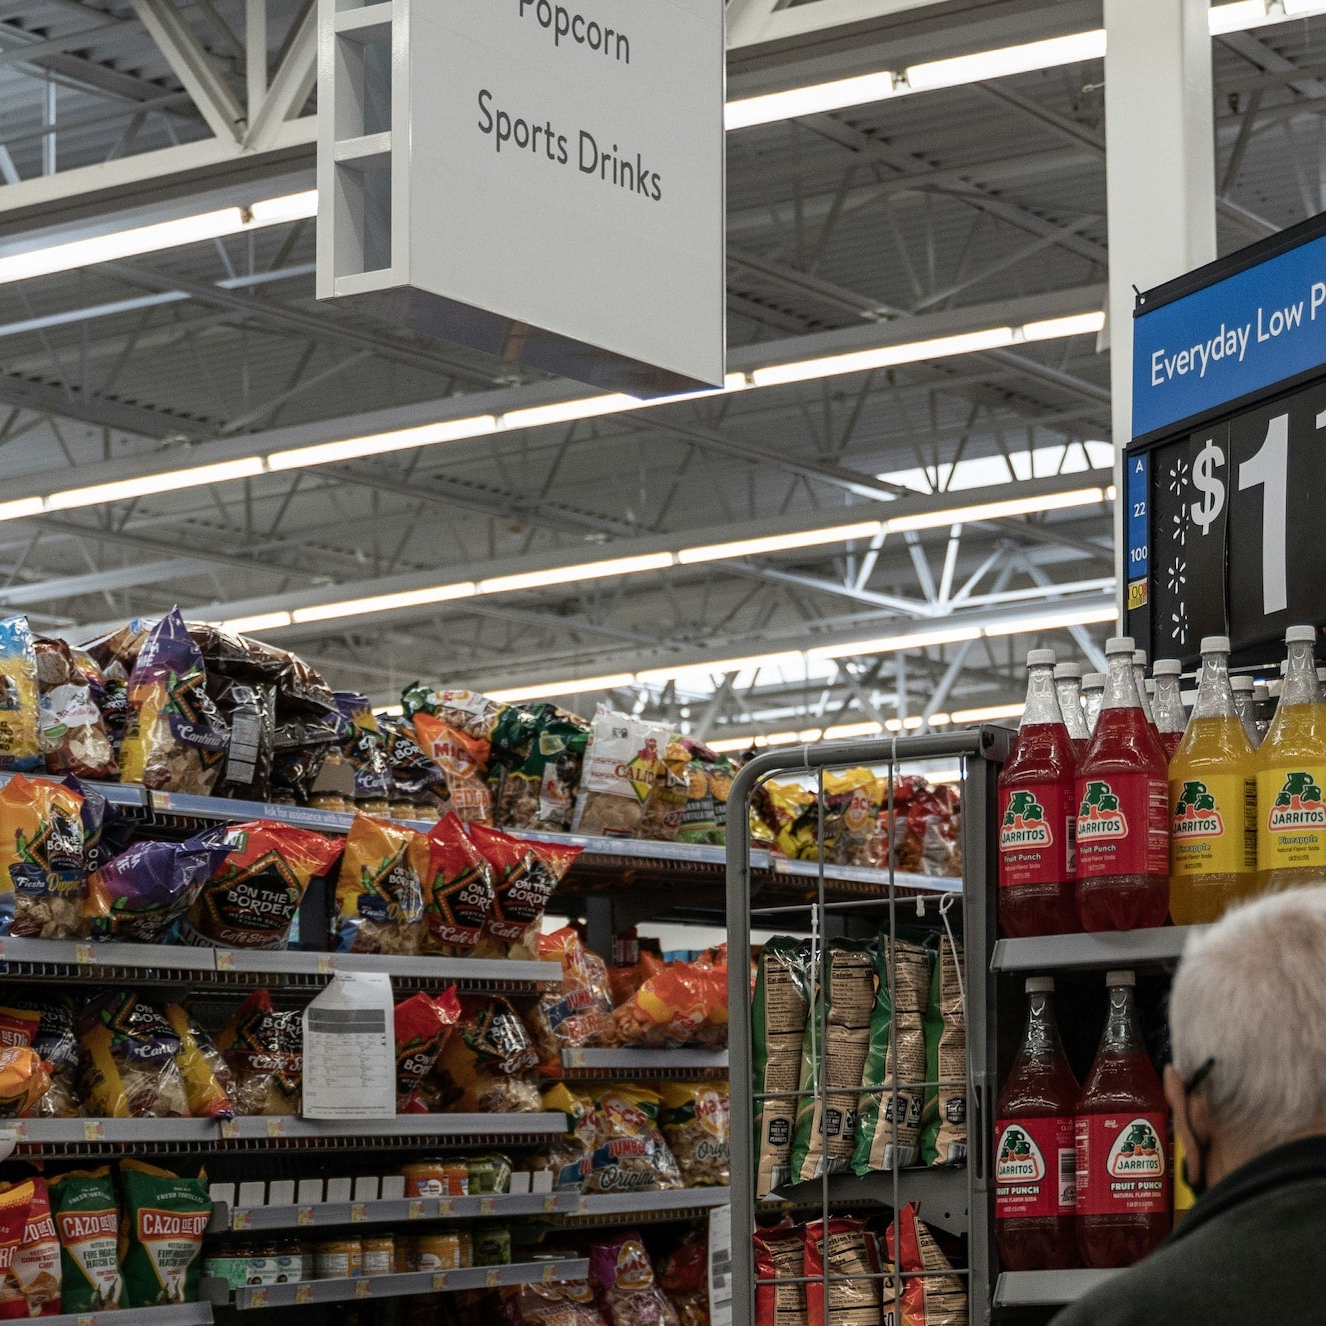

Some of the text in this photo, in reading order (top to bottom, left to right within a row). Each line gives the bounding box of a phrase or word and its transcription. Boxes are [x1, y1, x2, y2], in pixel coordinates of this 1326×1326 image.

[478, 90, 662, 201] Sports Drinks
[1150, 323, 1251, 387] Everyday
[1257, 301, 1302, 343] Low
[1135, 459, 1144, 474] A
[1134, 502, 1145, 517] 22
[1130, 546, 1148, 562] 100
[177, 725, 222, 747] Cantina
[1273, 811, 1324, 825] JARRITOS
[1078, 821, 1120, 834] JARRITOS
[1174, 820, 1217, 833] JARRITOS
[1002, 830, 1045, 843] JARRITOS
[1278, 836, 1318, 845] Pineapple
[1019, 854, 1041, 862] Punch
[17, 876, 45, 889] Fiesta
[515, 880, 552, 896] ON THE
[236, 884, 288, 904] ON THE
[227, 891, 294, 919] BORDER
[439, 925, 467, 945] Café
[489, 922, 521, 939] Café
[609, 1139, 646, 1158] JUMBO
[999, 1164, 1033, 1176] JARRITOS
[1117, 1159, 1158, 1171] JARRITOS
[1011, 1185, 1039, 1195] PUNCH
[1111, 1181, 1162, 1190] FRUIT PUNCH
[63, 1215, 98, 1238] CAZO
[143, 1213, 193, 1235] CAZO DE
